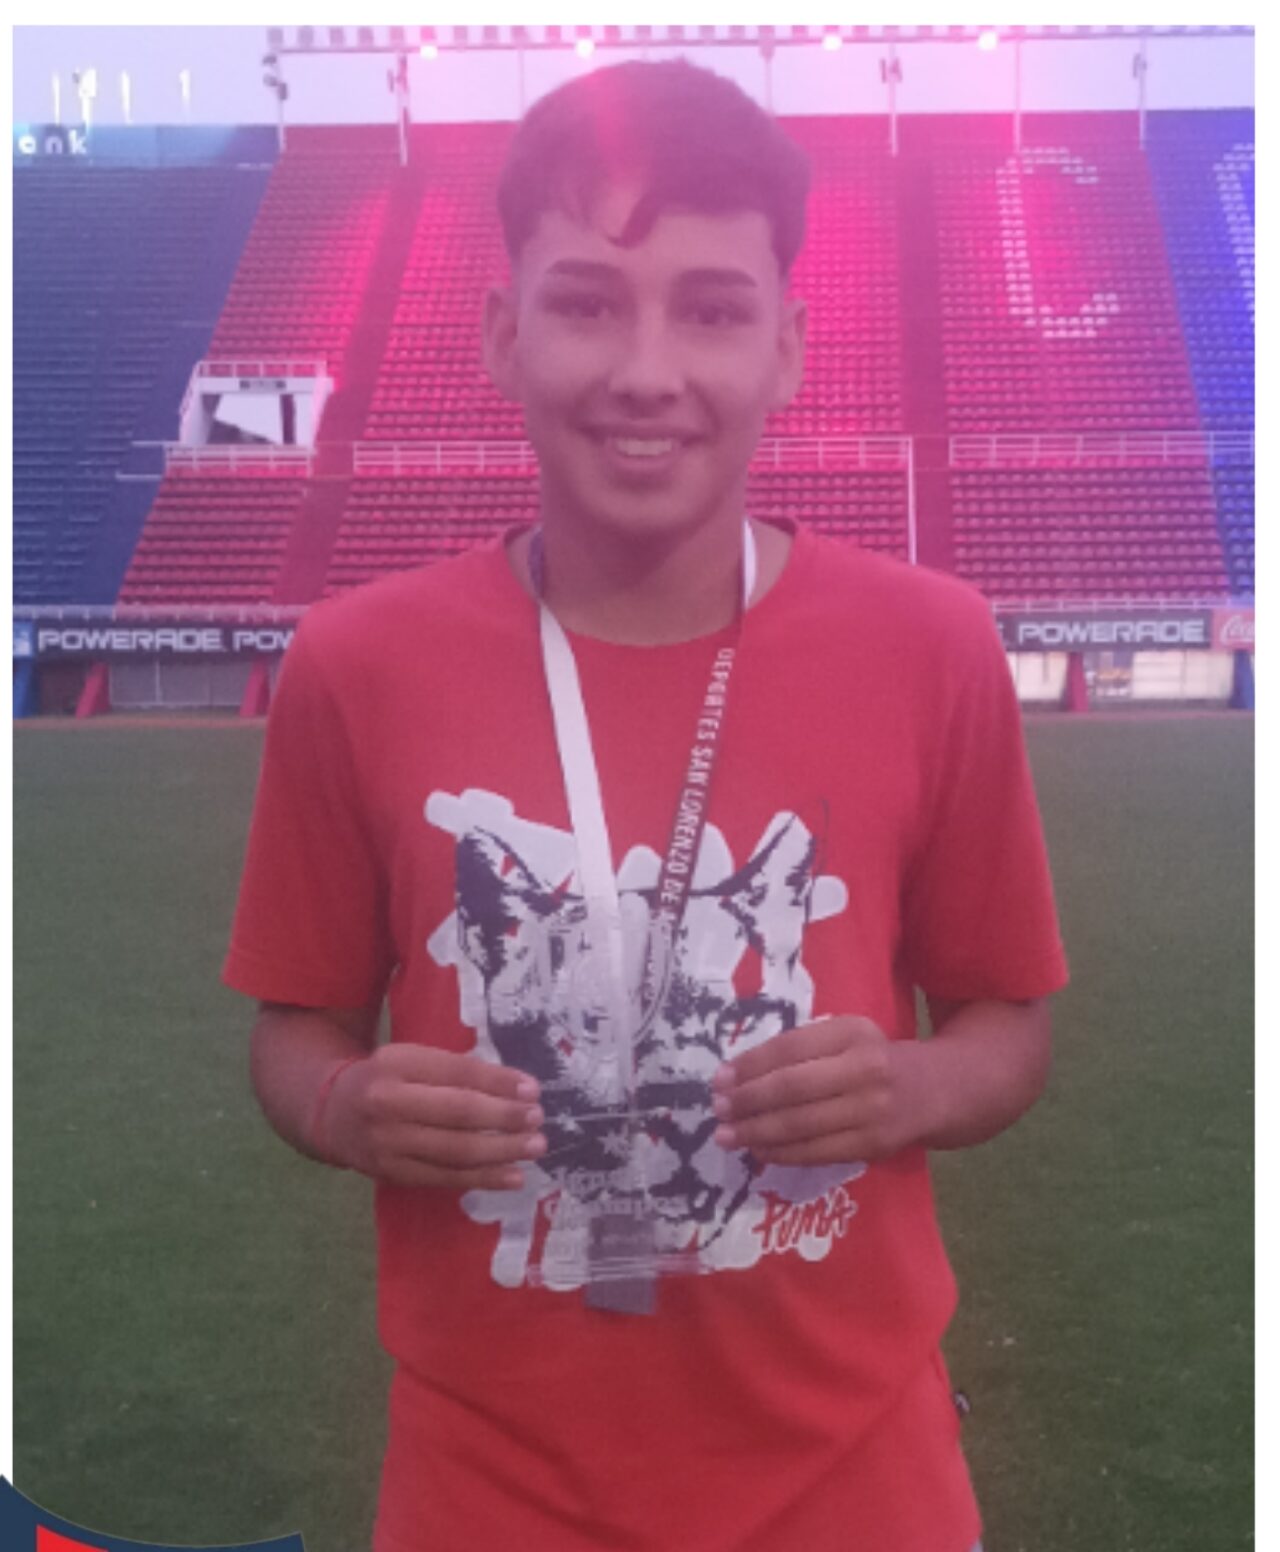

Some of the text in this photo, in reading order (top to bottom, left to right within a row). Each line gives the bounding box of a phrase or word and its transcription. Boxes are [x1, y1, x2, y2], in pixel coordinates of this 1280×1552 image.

[687, 745, 714, 785] SAN
[667, 787, 706, 875] LORENZO
[753, 1190, 856, 1250] PUMA
